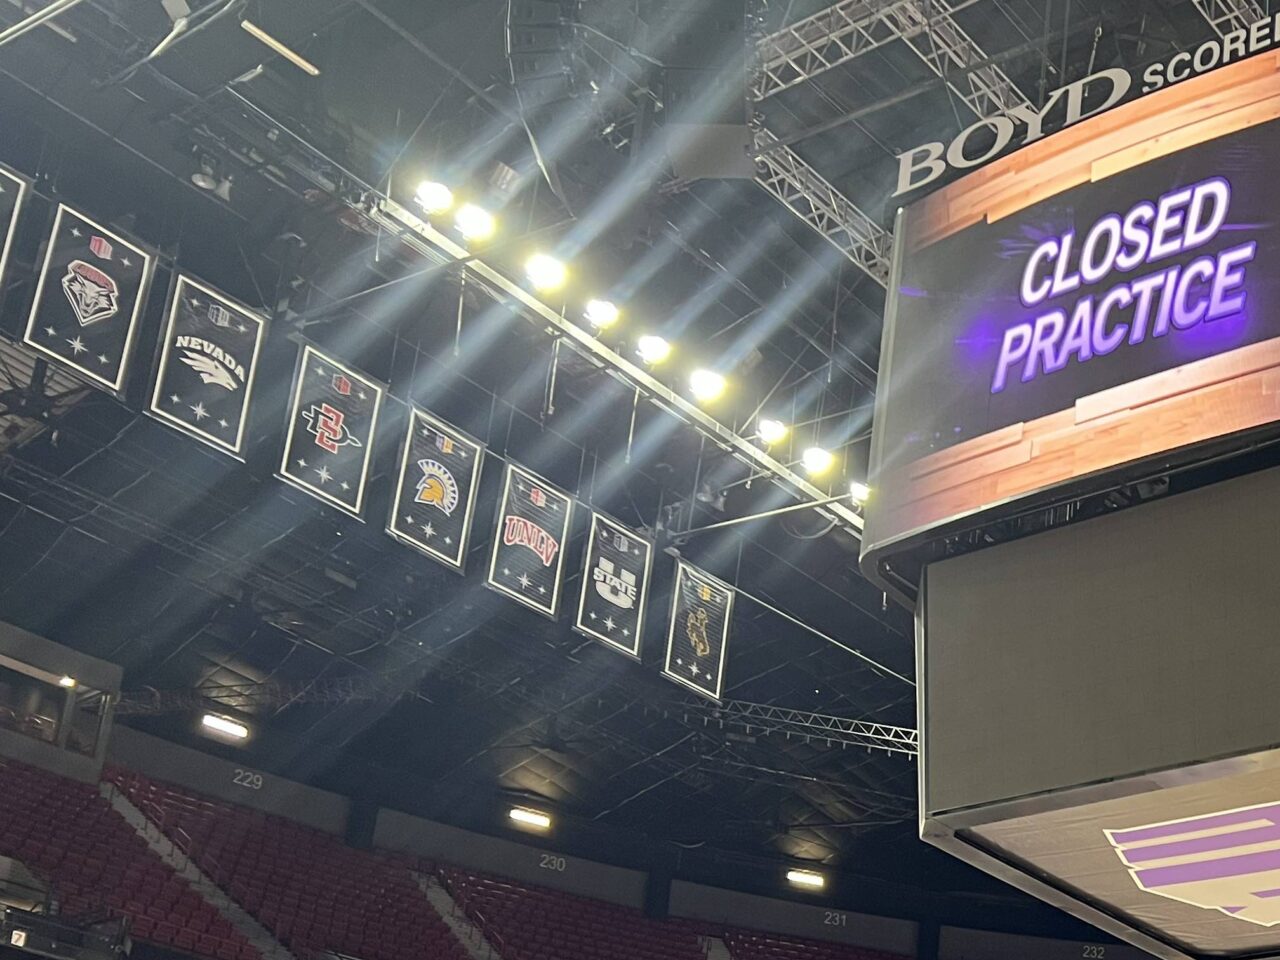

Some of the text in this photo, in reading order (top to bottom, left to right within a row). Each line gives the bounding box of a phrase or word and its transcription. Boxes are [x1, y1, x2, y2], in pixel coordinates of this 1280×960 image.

[892, 68, 1132, 197] BOYD
[1022, 179, 1229, 306] CLOSED
[992, 243, 1255, 392] PRACTICE
[175, 336, 245, 383] NEVADA
[504, 516, 559, 566] UNLV
[593, 567, 637, 601] STATE
[233, 769, 262, 789] 229
[540, 854, 566, 872] 230
[824, 911, 848, 927] 231
[1083, 946, 1105, 959] 232
